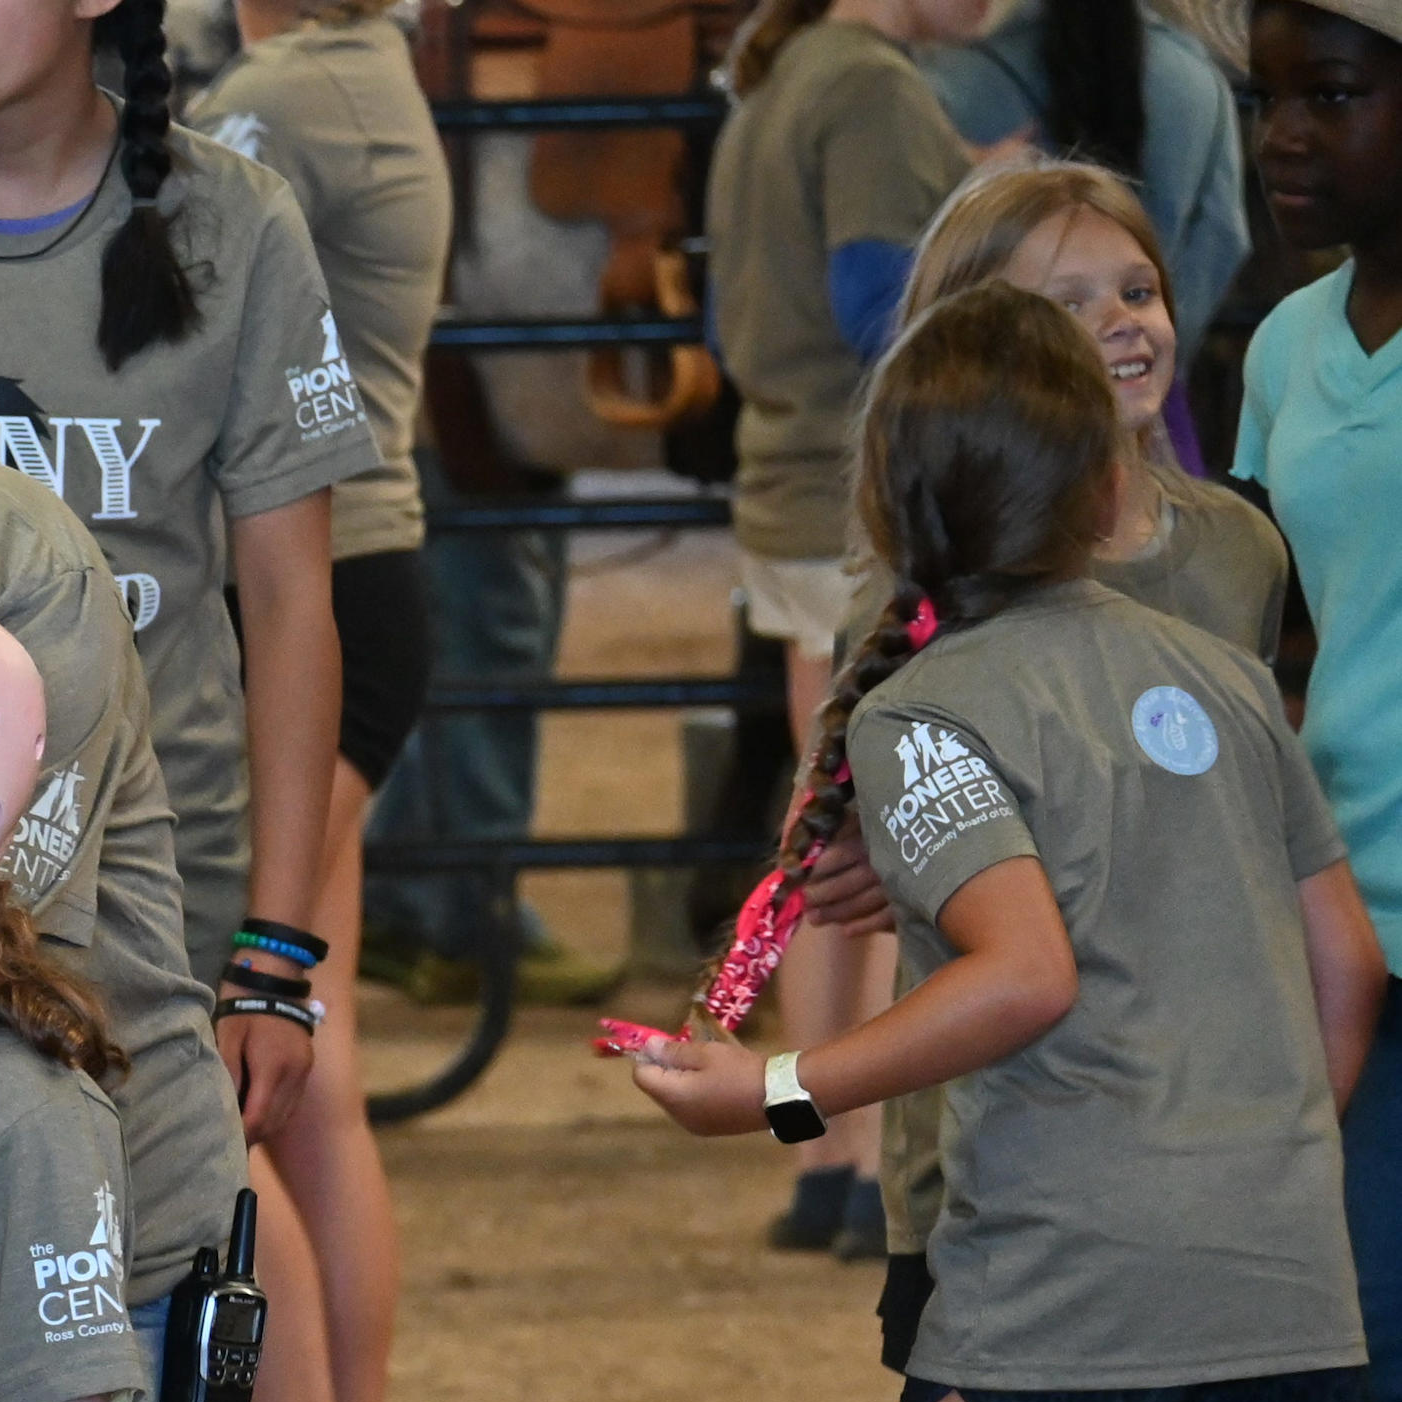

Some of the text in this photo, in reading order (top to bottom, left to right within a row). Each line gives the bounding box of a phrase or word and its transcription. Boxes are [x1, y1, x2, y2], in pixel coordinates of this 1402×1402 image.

[296, 384, 358, 429] CEN
[885, 756, 992, 842] PIONEER
[900, 779, 1008, 863] CENTER
[955, 811, 989, 832] Board
[29, 1243, 55, 1258] the
[44, 1330, 75, 1343] Ross
[78, 1321, 124, 1338] County
